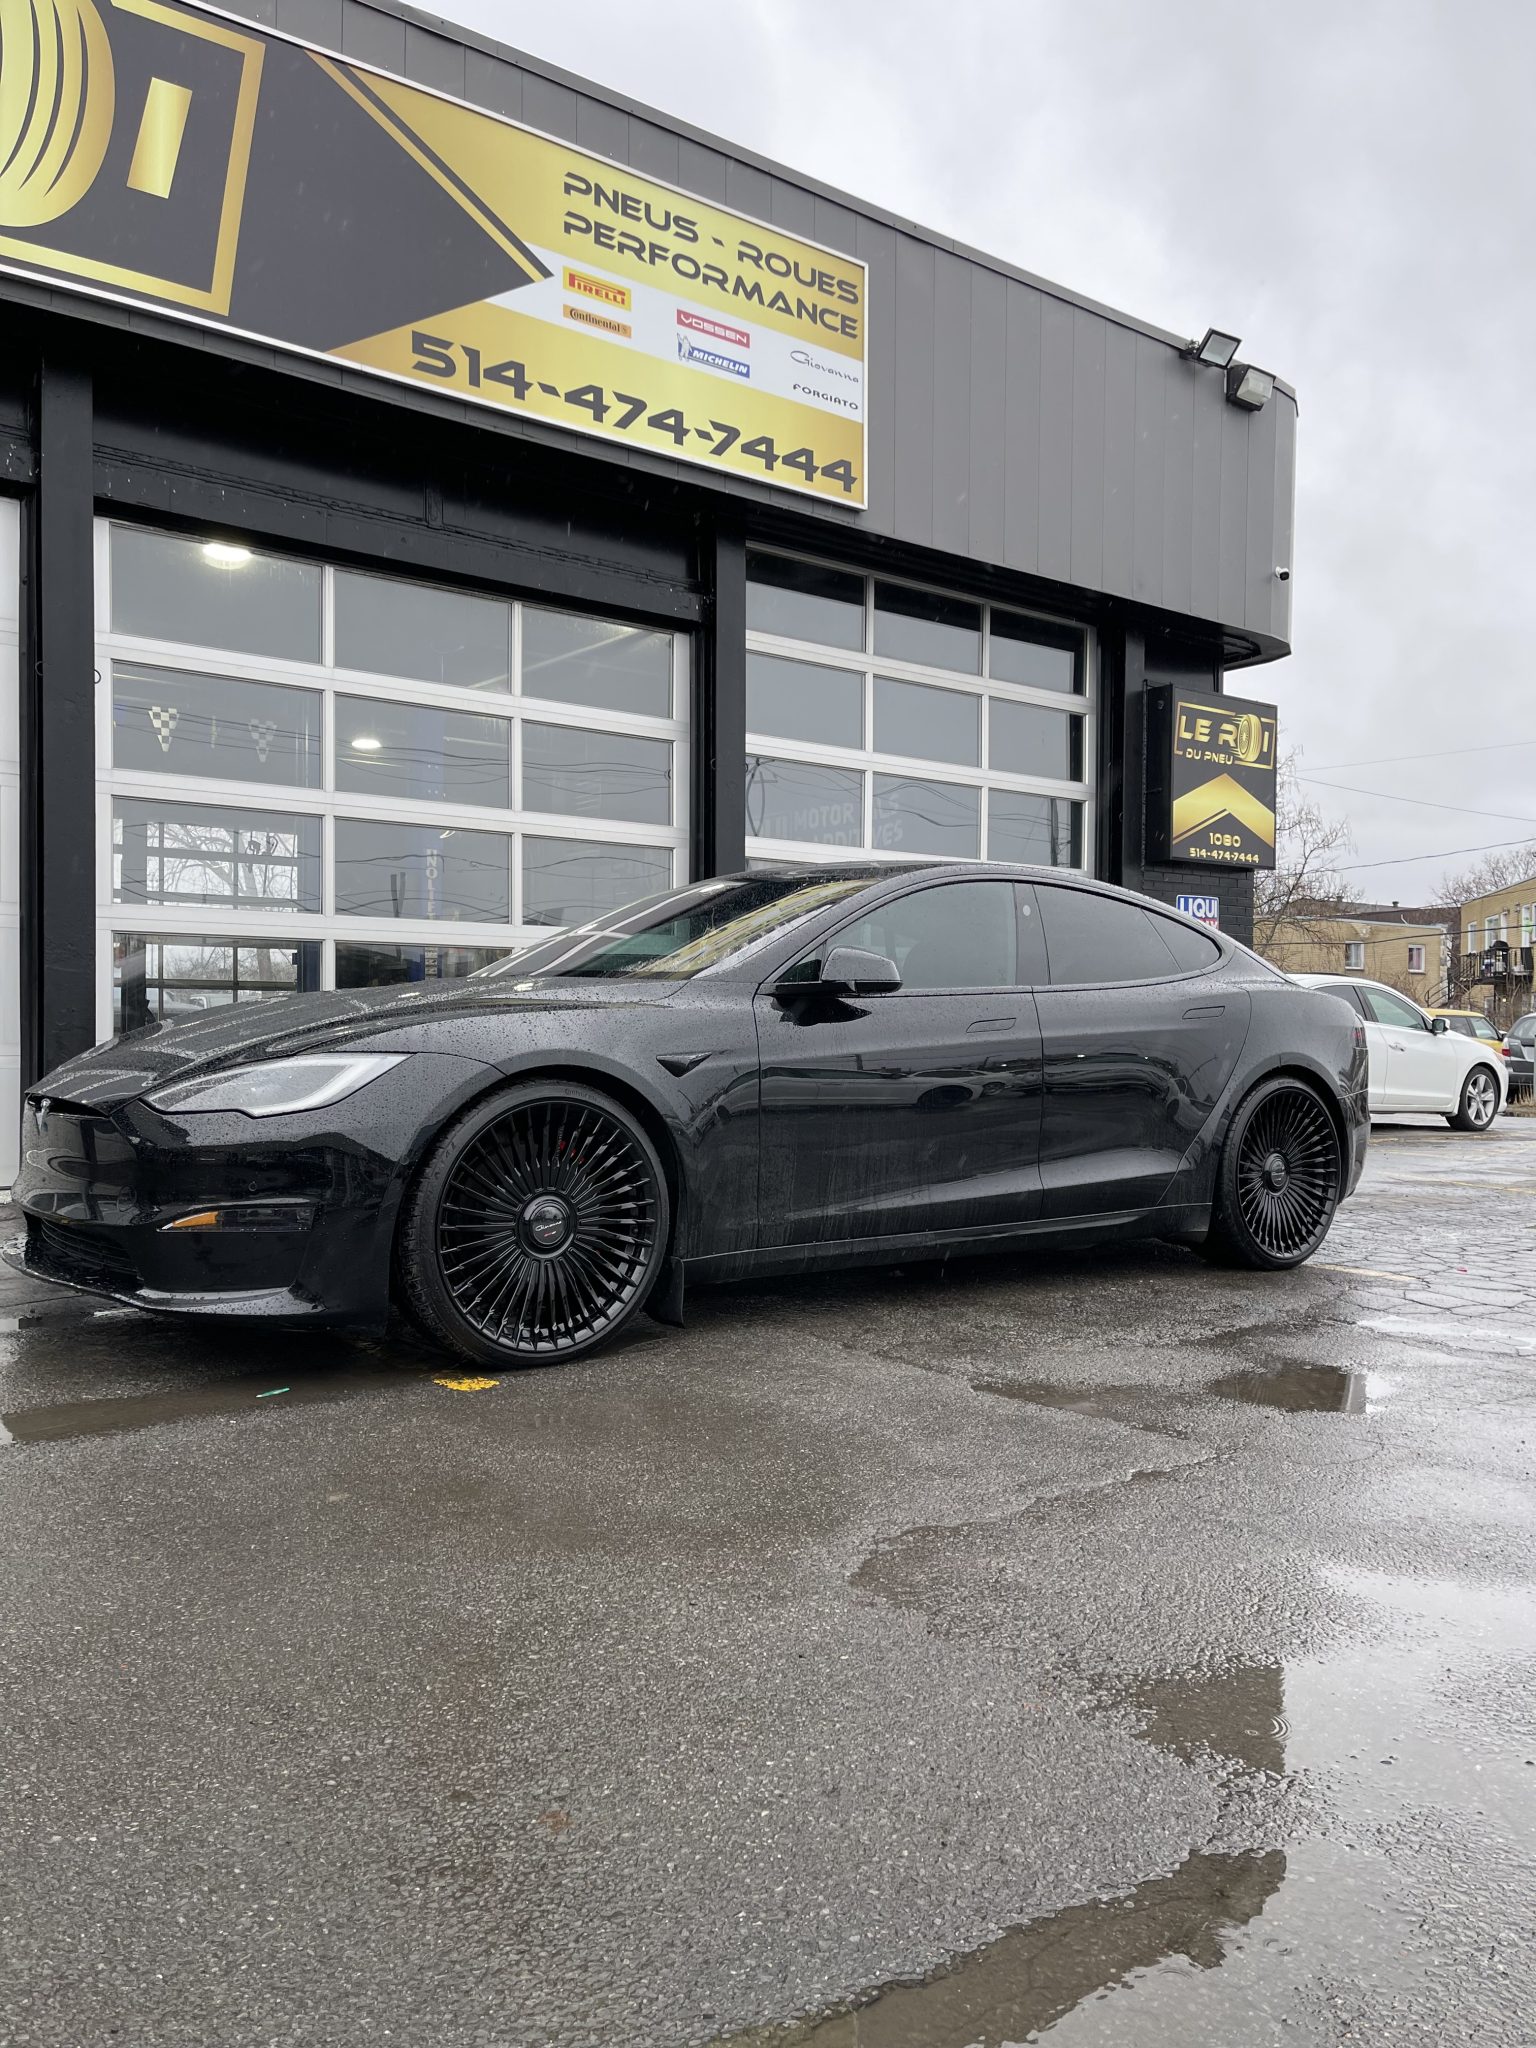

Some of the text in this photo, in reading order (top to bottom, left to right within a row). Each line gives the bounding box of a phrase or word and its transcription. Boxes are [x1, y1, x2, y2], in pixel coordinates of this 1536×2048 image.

[563, 171, 699, 243] PNEUS
[737, 240, 859, 304] ROUES
[563, 210, 859, 340] PERFORMANCE
[568, 272, 626, 305] PIRELLI
[570, 308, 620, 332] Continental
[680, 313, 747, 344] VOSSEN
[692, 349, 749, 374] MICHELIN
[790, 350, 859, 383] Giovanna
[793, 383, 859, 410] FORGIATO
[411, 330, 858, 493] 514-474-7444
[1180, 715, 1212, 742] LE
[1185, 748, 1233, 765] DU PNEU
[794, 803, 855, 832] MOTOR
[1209, 832, 1241, 848] 1080
[1189, 847, 1260, 863] 514-474-7444
[1180, 898, 1218, 919] LIQUI
